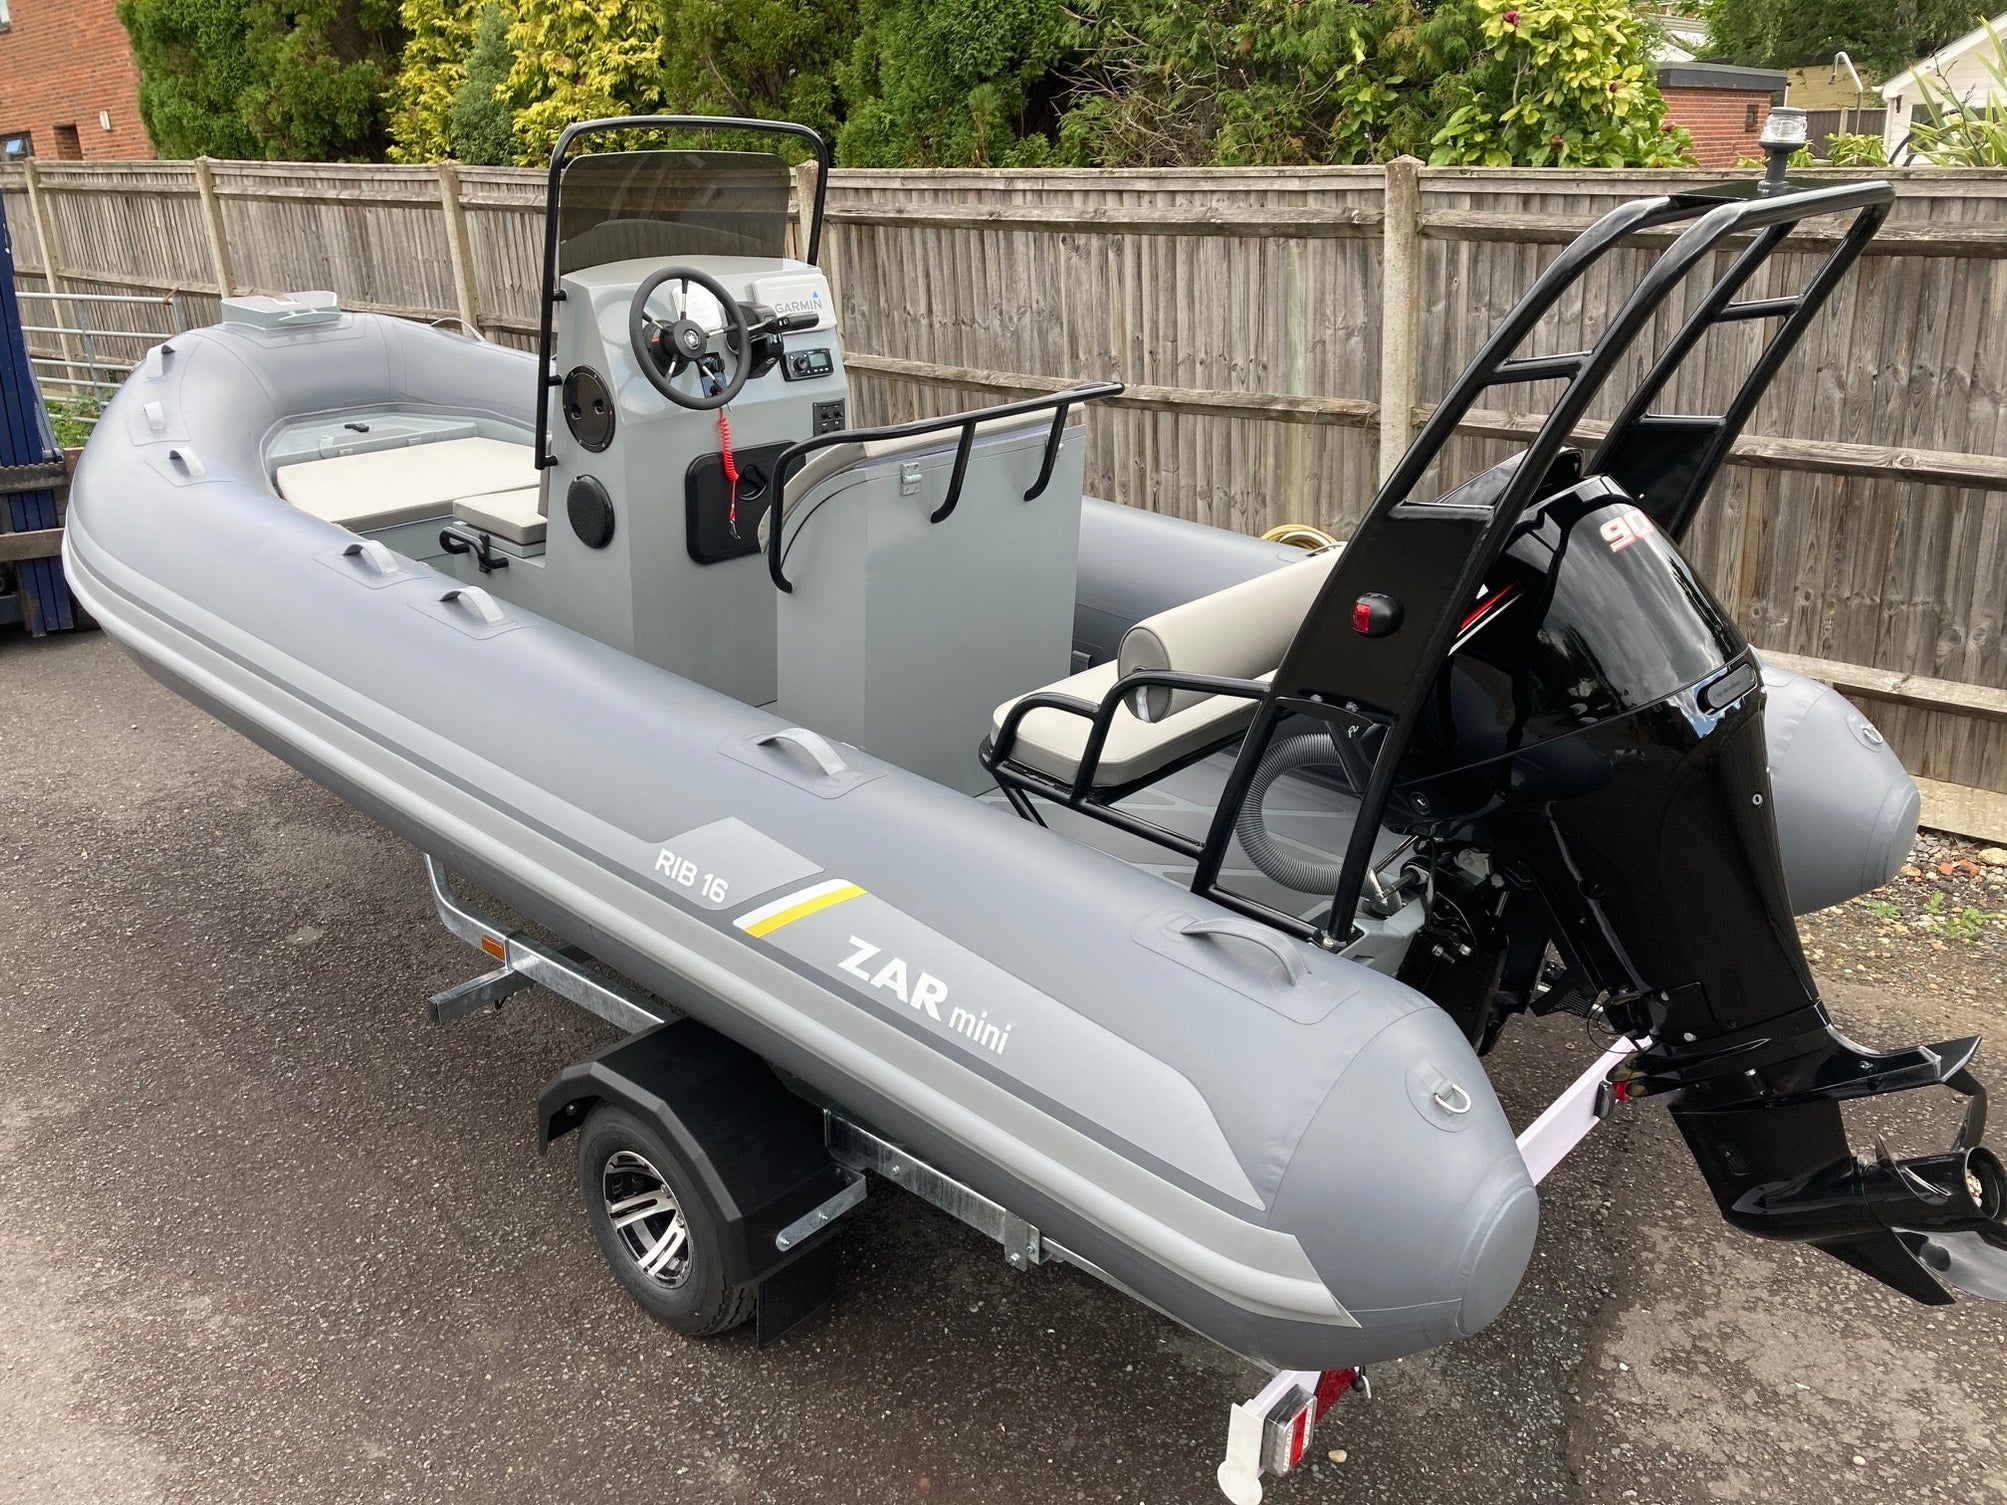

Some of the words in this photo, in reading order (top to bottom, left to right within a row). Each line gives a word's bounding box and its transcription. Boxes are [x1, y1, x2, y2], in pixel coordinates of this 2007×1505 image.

[775, 299, 822, 313] GARMIN
[1600, 510, 1655, 553] 90
[655, 848, 697, 887] RIB
[703, 873, 729, 902] 16
[837, 935, 948, 1021] ZAR
[949, 1006, 1013, 1055] mini
